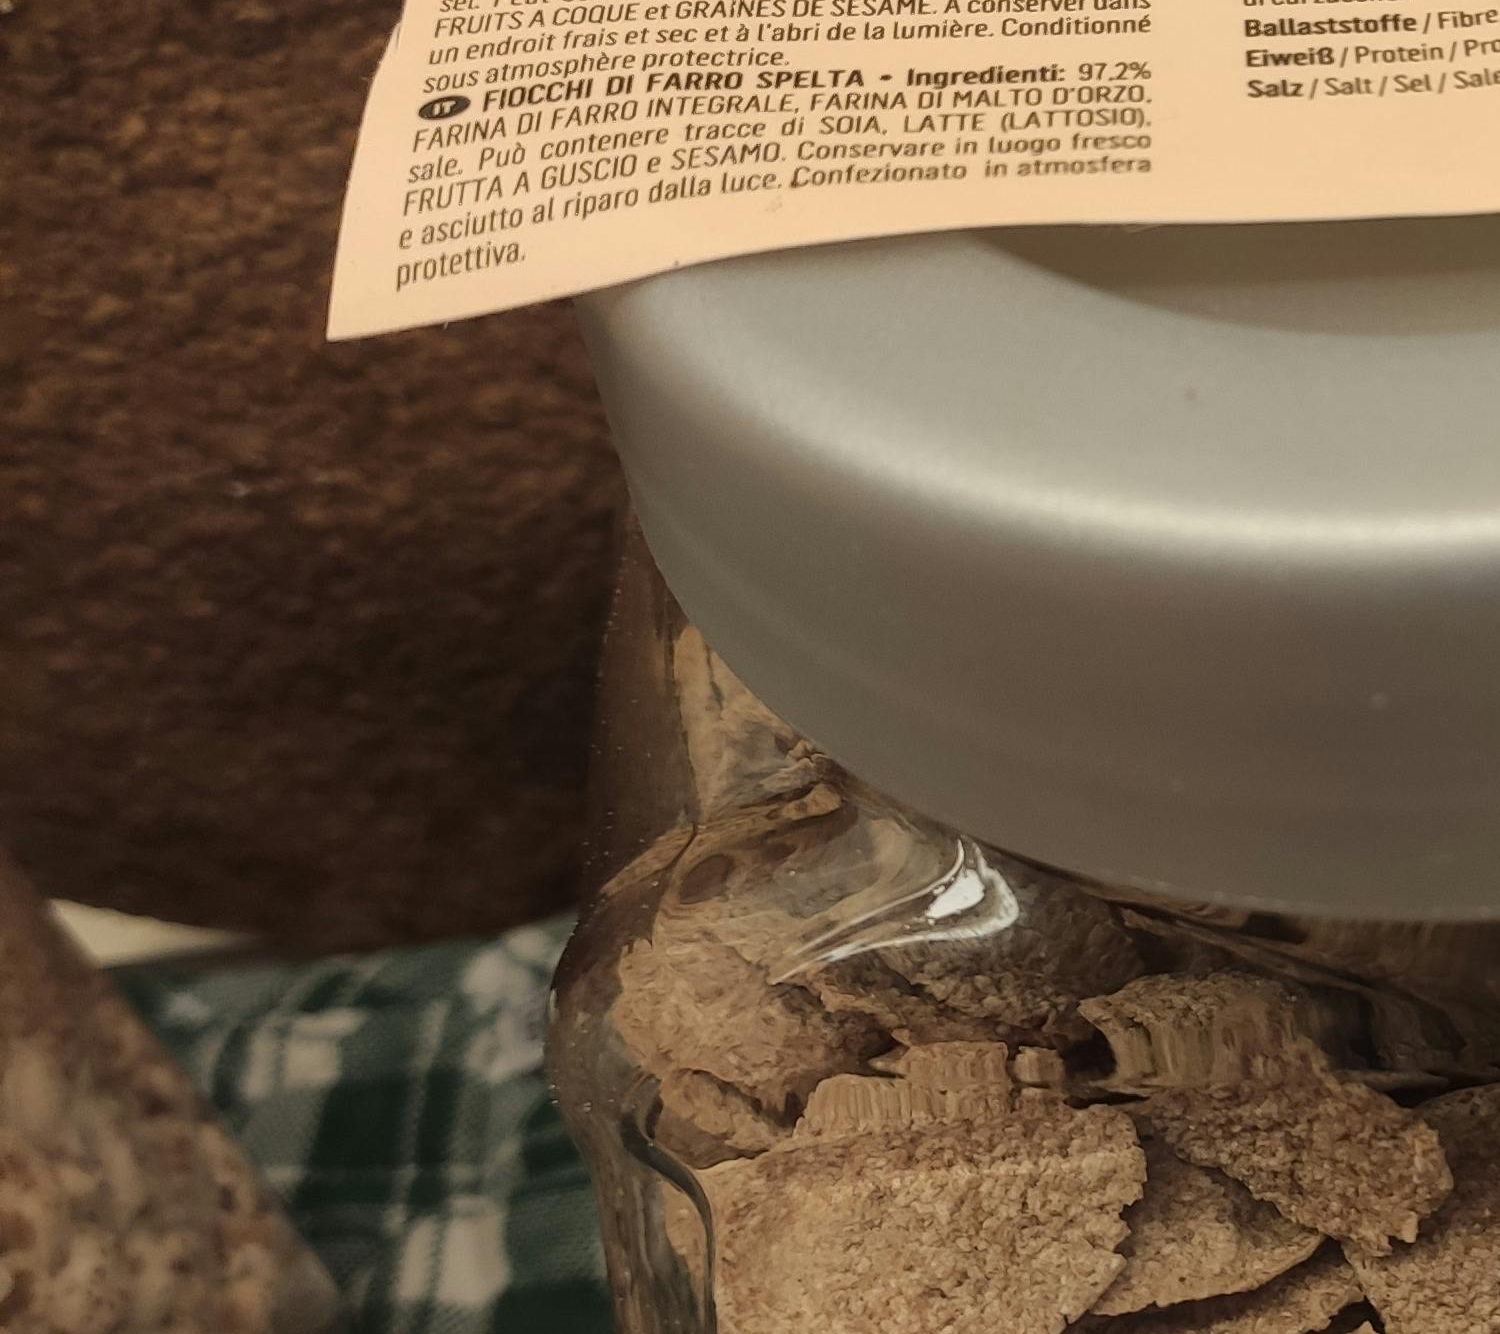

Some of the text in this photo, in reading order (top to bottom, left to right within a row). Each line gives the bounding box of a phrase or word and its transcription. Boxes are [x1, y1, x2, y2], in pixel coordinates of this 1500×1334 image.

[434, 11, 522, 39] FRUITS
[552, 3, 644, 26] COQUE
[466, 18, 1151, 61] endroit frais sec Conditionné
[1244, 15, 1417, 38] Ballaststoffe
[1437, 6, 1499, 30] Fibre
[422, 52, 636, 95] sous atmosphère
[1245, 48, 1334, 67] Eiweiß
[1354, 43, 1444, 64] Protein
[482, 79, 593, 112] FIOCCHI
[646, 72, 743, 93] FARRO
[756, 69, 864, 89] SPELTA
[1248, 80, 1304, 98] Salz
[1325, 77, 1373, 96] Salt
[1393, 74, 1432, 93] Sel
[412, 89, 1042, 153] FARINA FARRO FARINA MALTO
[479, 114, 986, 171] Può contenere tracce LATTE
[404, 133, 1152, 216] FRUTTA GUSCIO Conservare luogo fresco
[422, 157, 1152, 246] asciutto riparo dalla atmosfera
